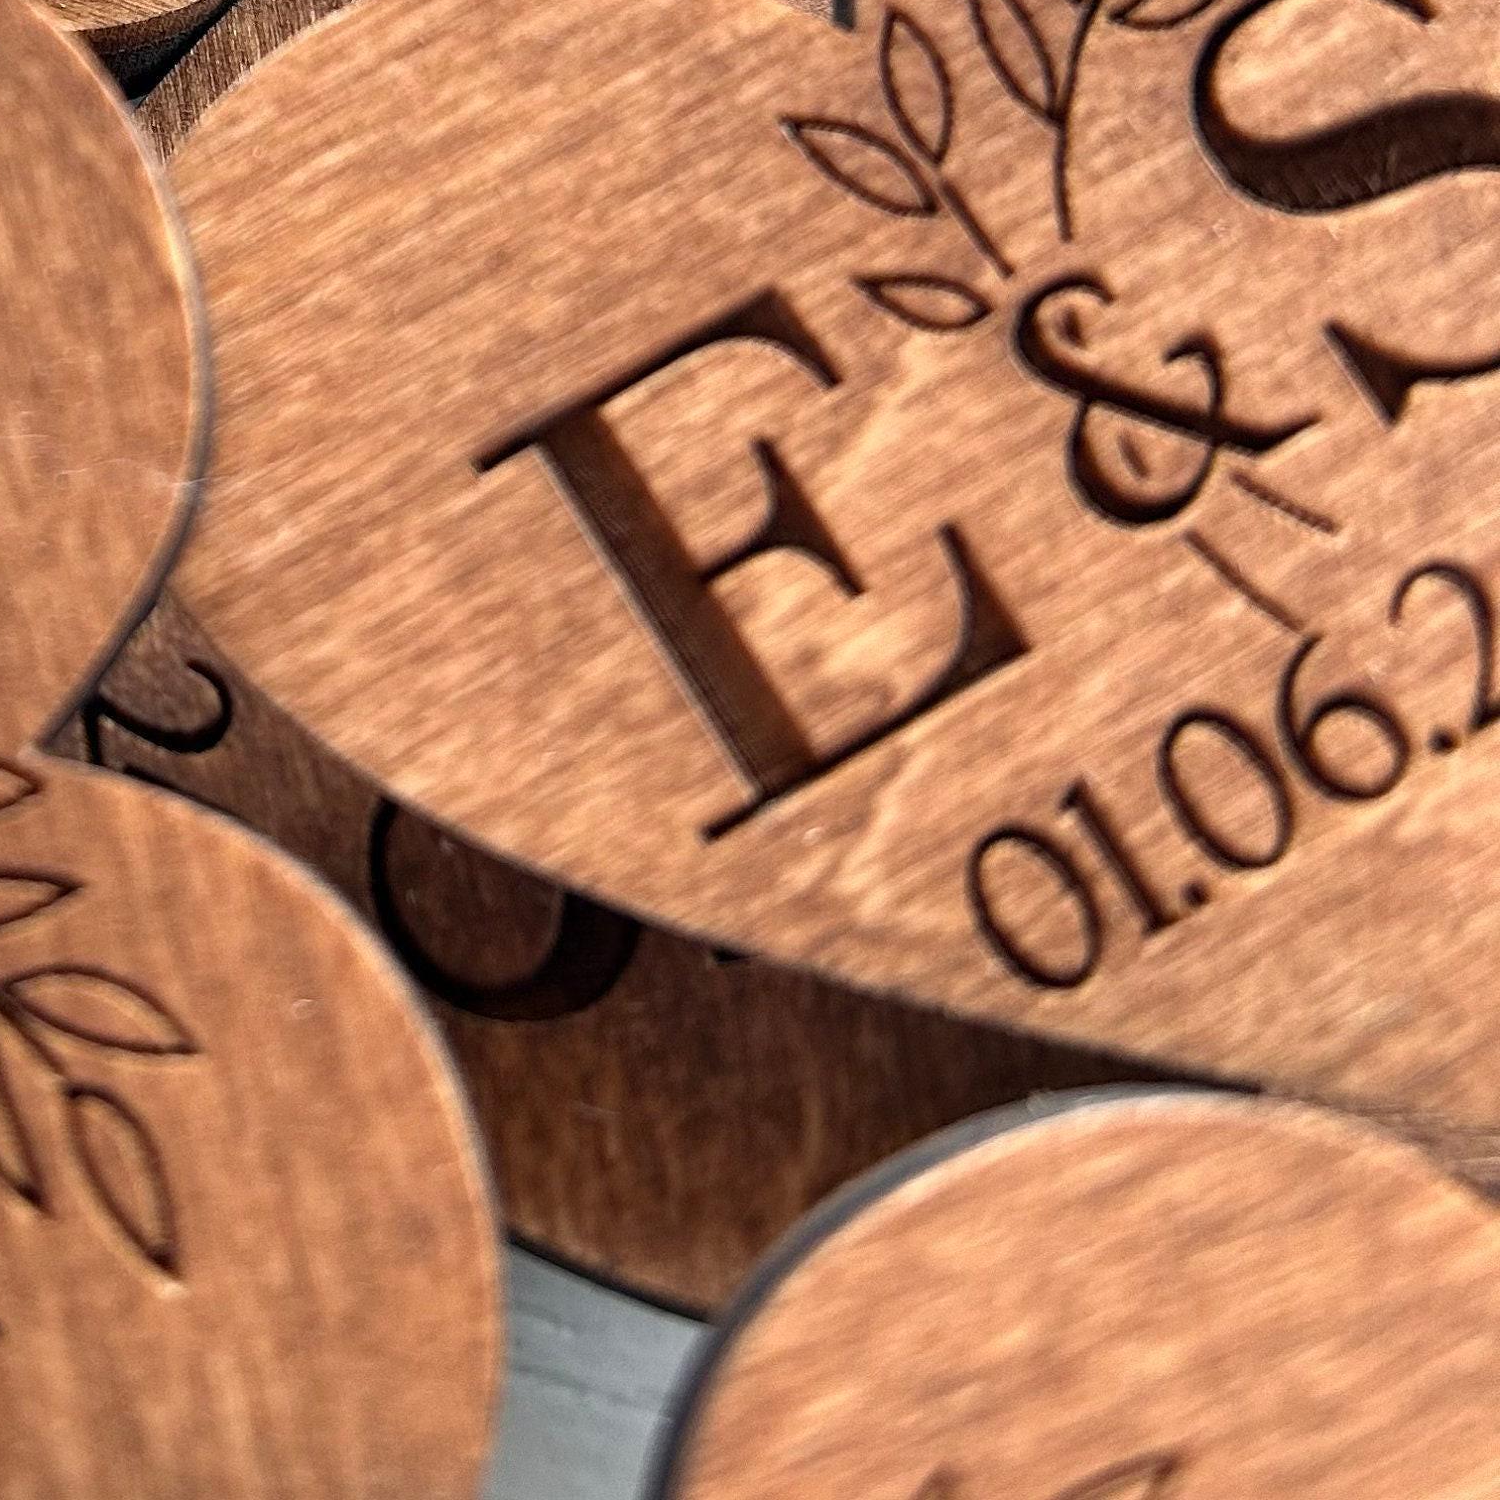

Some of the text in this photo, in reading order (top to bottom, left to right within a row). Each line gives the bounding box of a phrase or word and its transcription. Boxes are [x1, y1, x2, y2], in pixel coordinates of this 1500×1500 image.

[470, 289, 1032, 845] E
[1011, 271, 1323, 530] &
[965, 556, 1500, 990] 01.06.2
